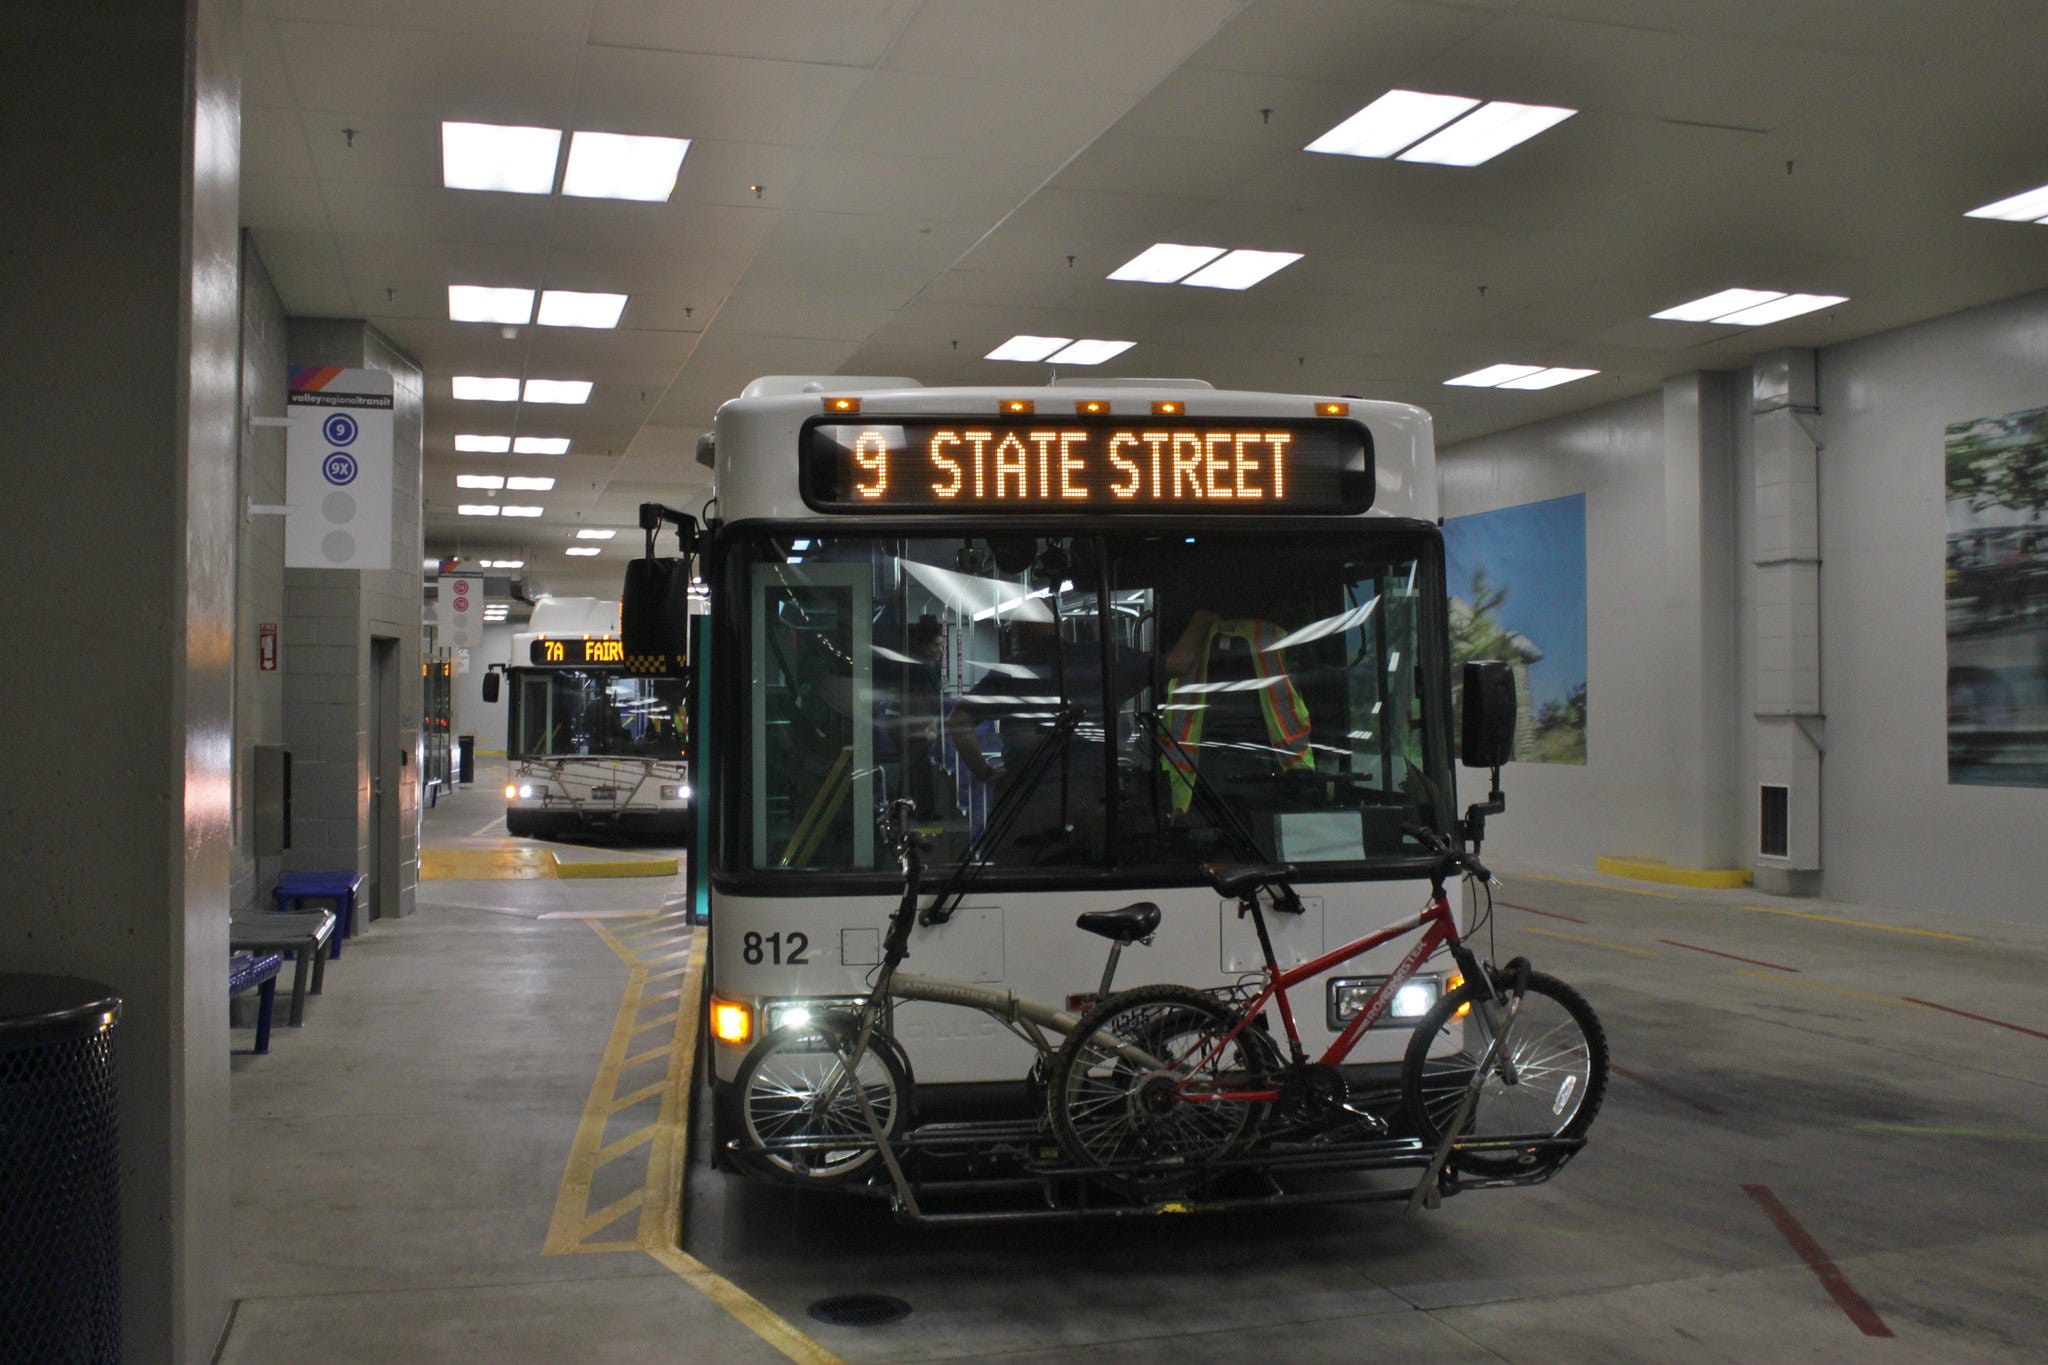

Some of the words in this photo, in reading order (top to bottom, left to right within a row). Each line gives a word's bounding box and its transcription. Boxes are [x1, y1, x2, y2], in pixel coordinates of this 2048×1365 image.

[336, 424, 346, 437] 9
[331, 462, 349, 476] 9X
[856, 431, 888, 498] 9
[930, 431, 1089, 498] STATE
[1109, 432, 1292, 498] STREET
[545, 641, 564, 661] 7A
[743, 930, 809, 966] 812
[1366, 939, 1428, 1021] ROADMASTER
